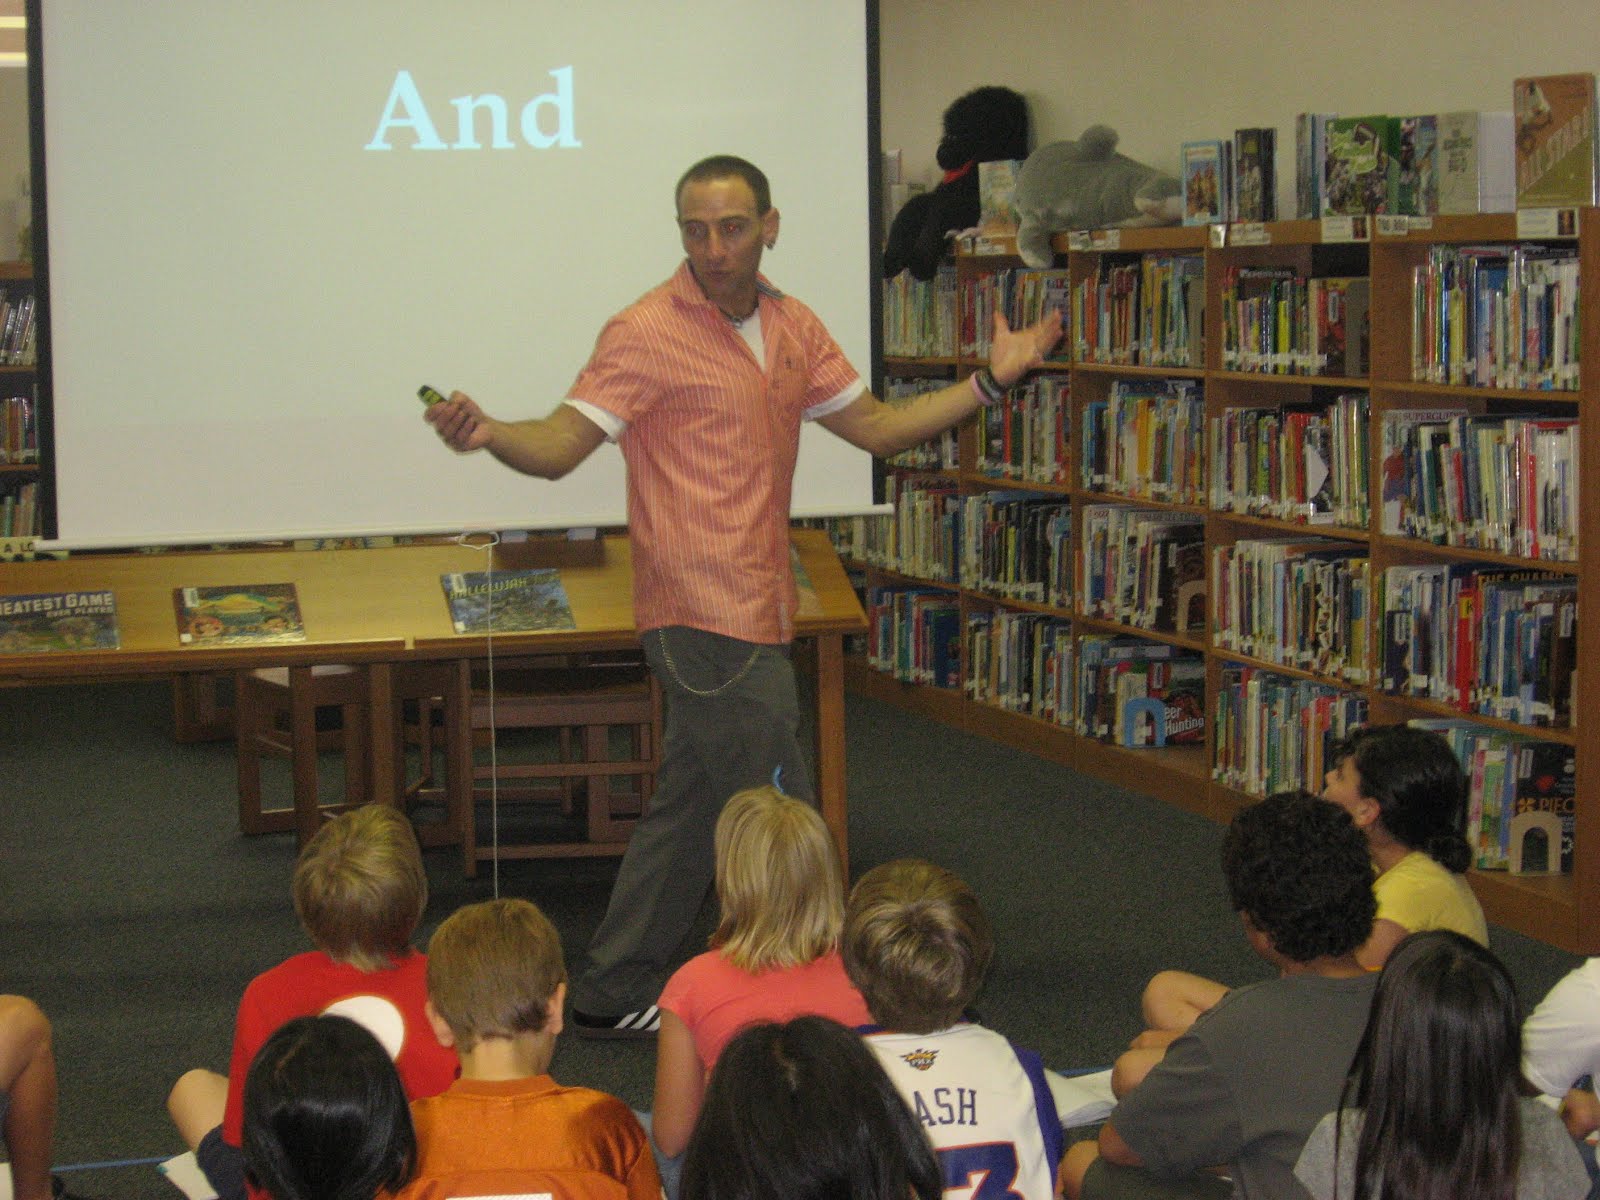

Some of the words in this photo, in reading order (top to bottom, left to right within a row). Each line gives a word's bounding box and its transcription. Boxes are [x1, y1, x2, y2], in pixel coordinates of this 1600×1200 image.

[363, 65, 582, 150] And
[0, 596, 63, 616] EATEST
[66, 592, 113, 608] GAME
[1164, 707, 1182, 720] eer
[1164, 716, 1205, 737] Hunting
